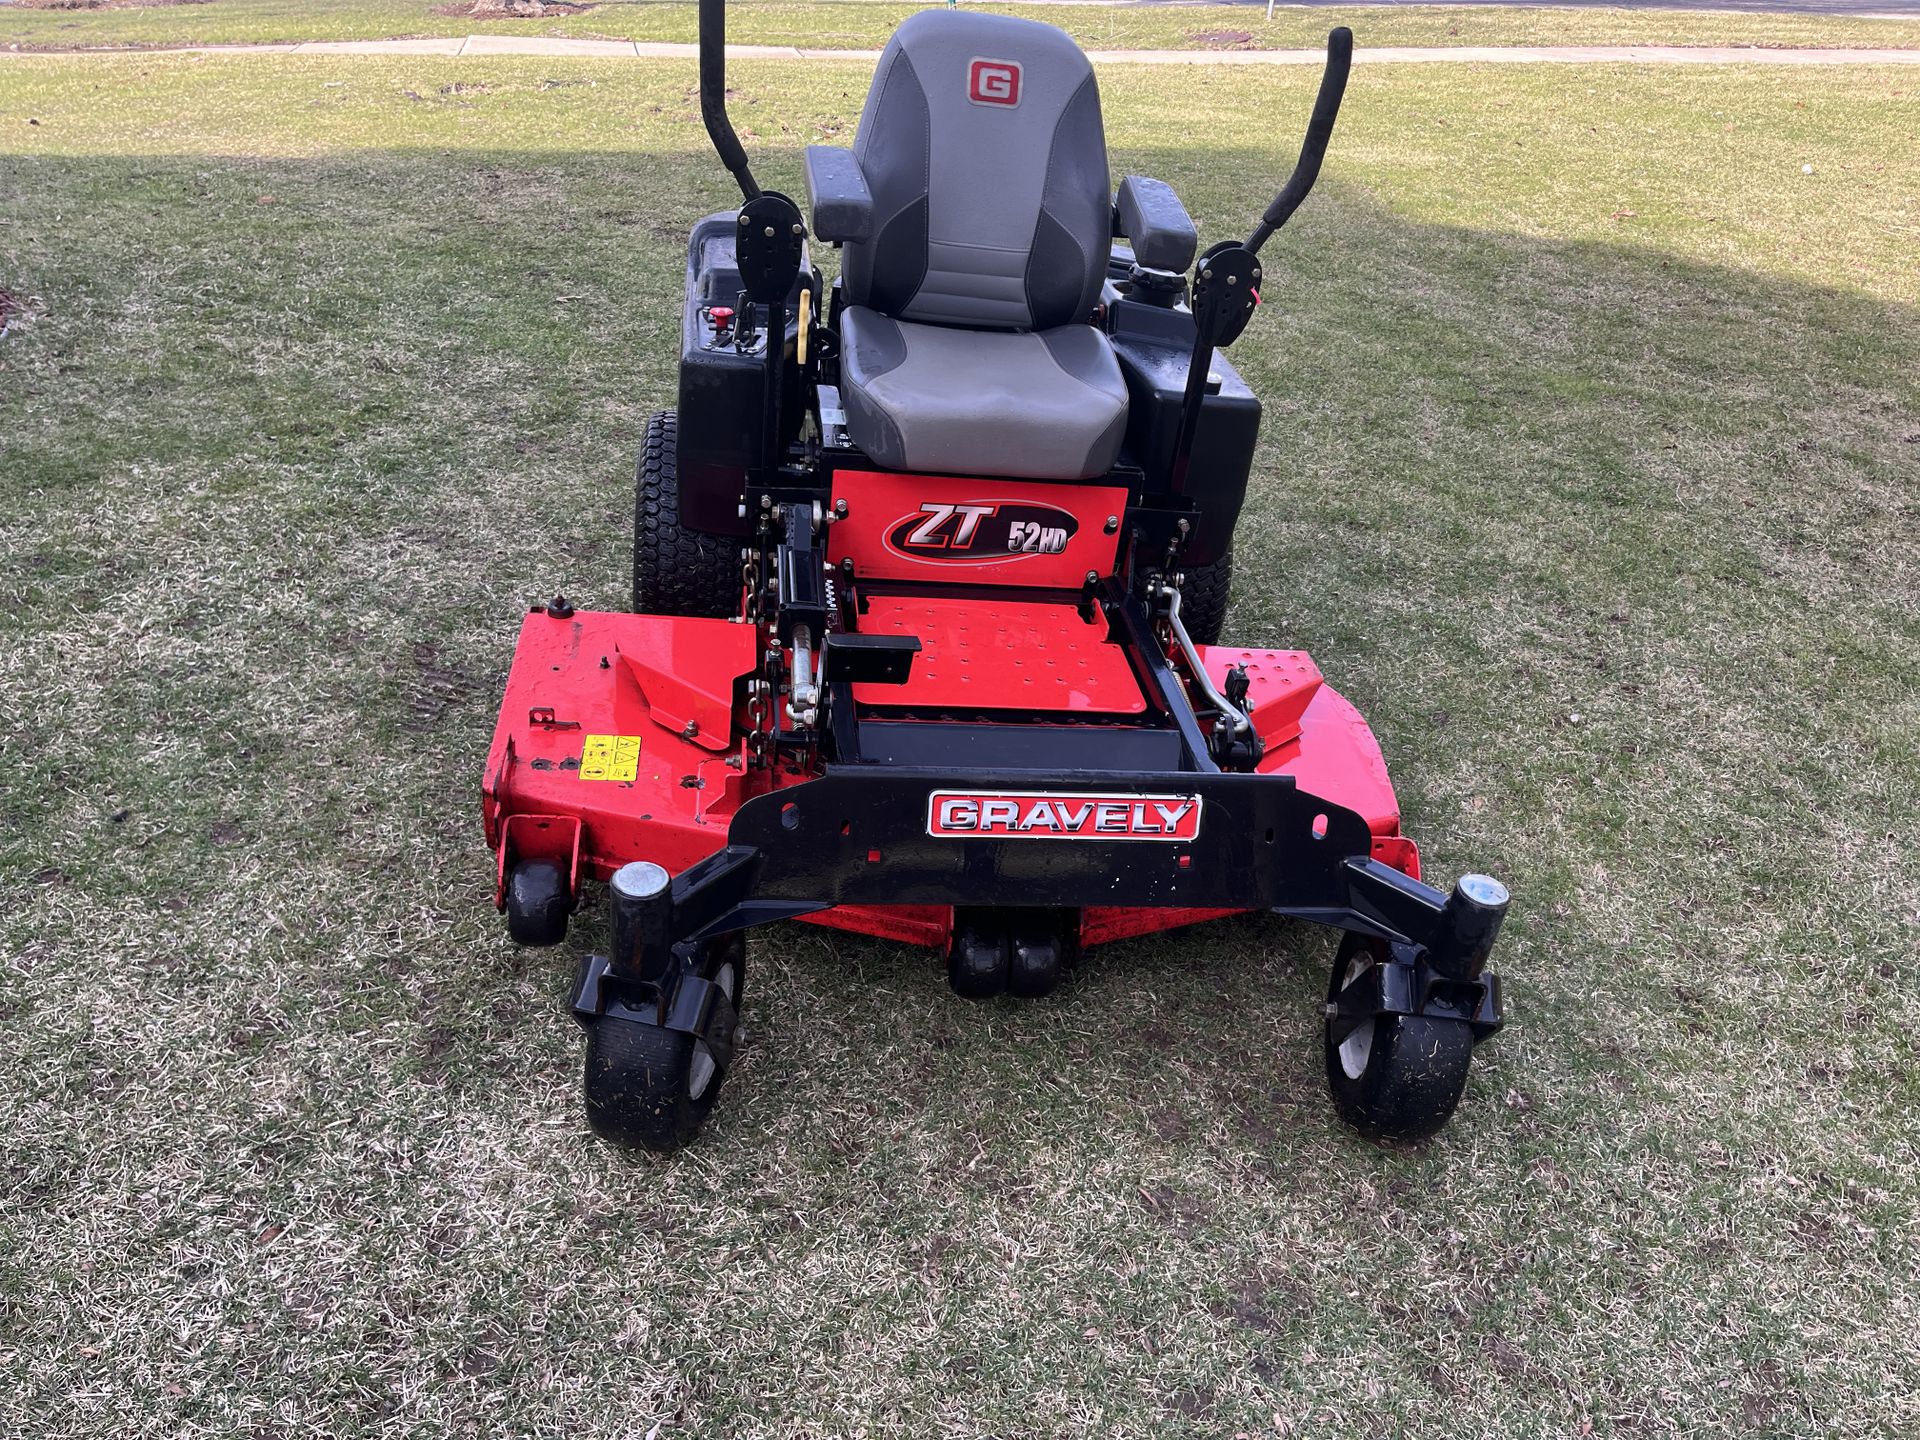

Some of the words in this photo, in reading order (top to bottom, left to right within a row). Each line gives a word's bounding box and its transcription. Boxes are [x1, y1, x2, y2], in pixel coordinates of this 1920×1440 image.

[978, 67, 1012, 99] G
[907, 502, 996, 547] ZT
[1007, 521, 1068, 554] 52HD
[939, 800, 1193, 833] GRAVELY
